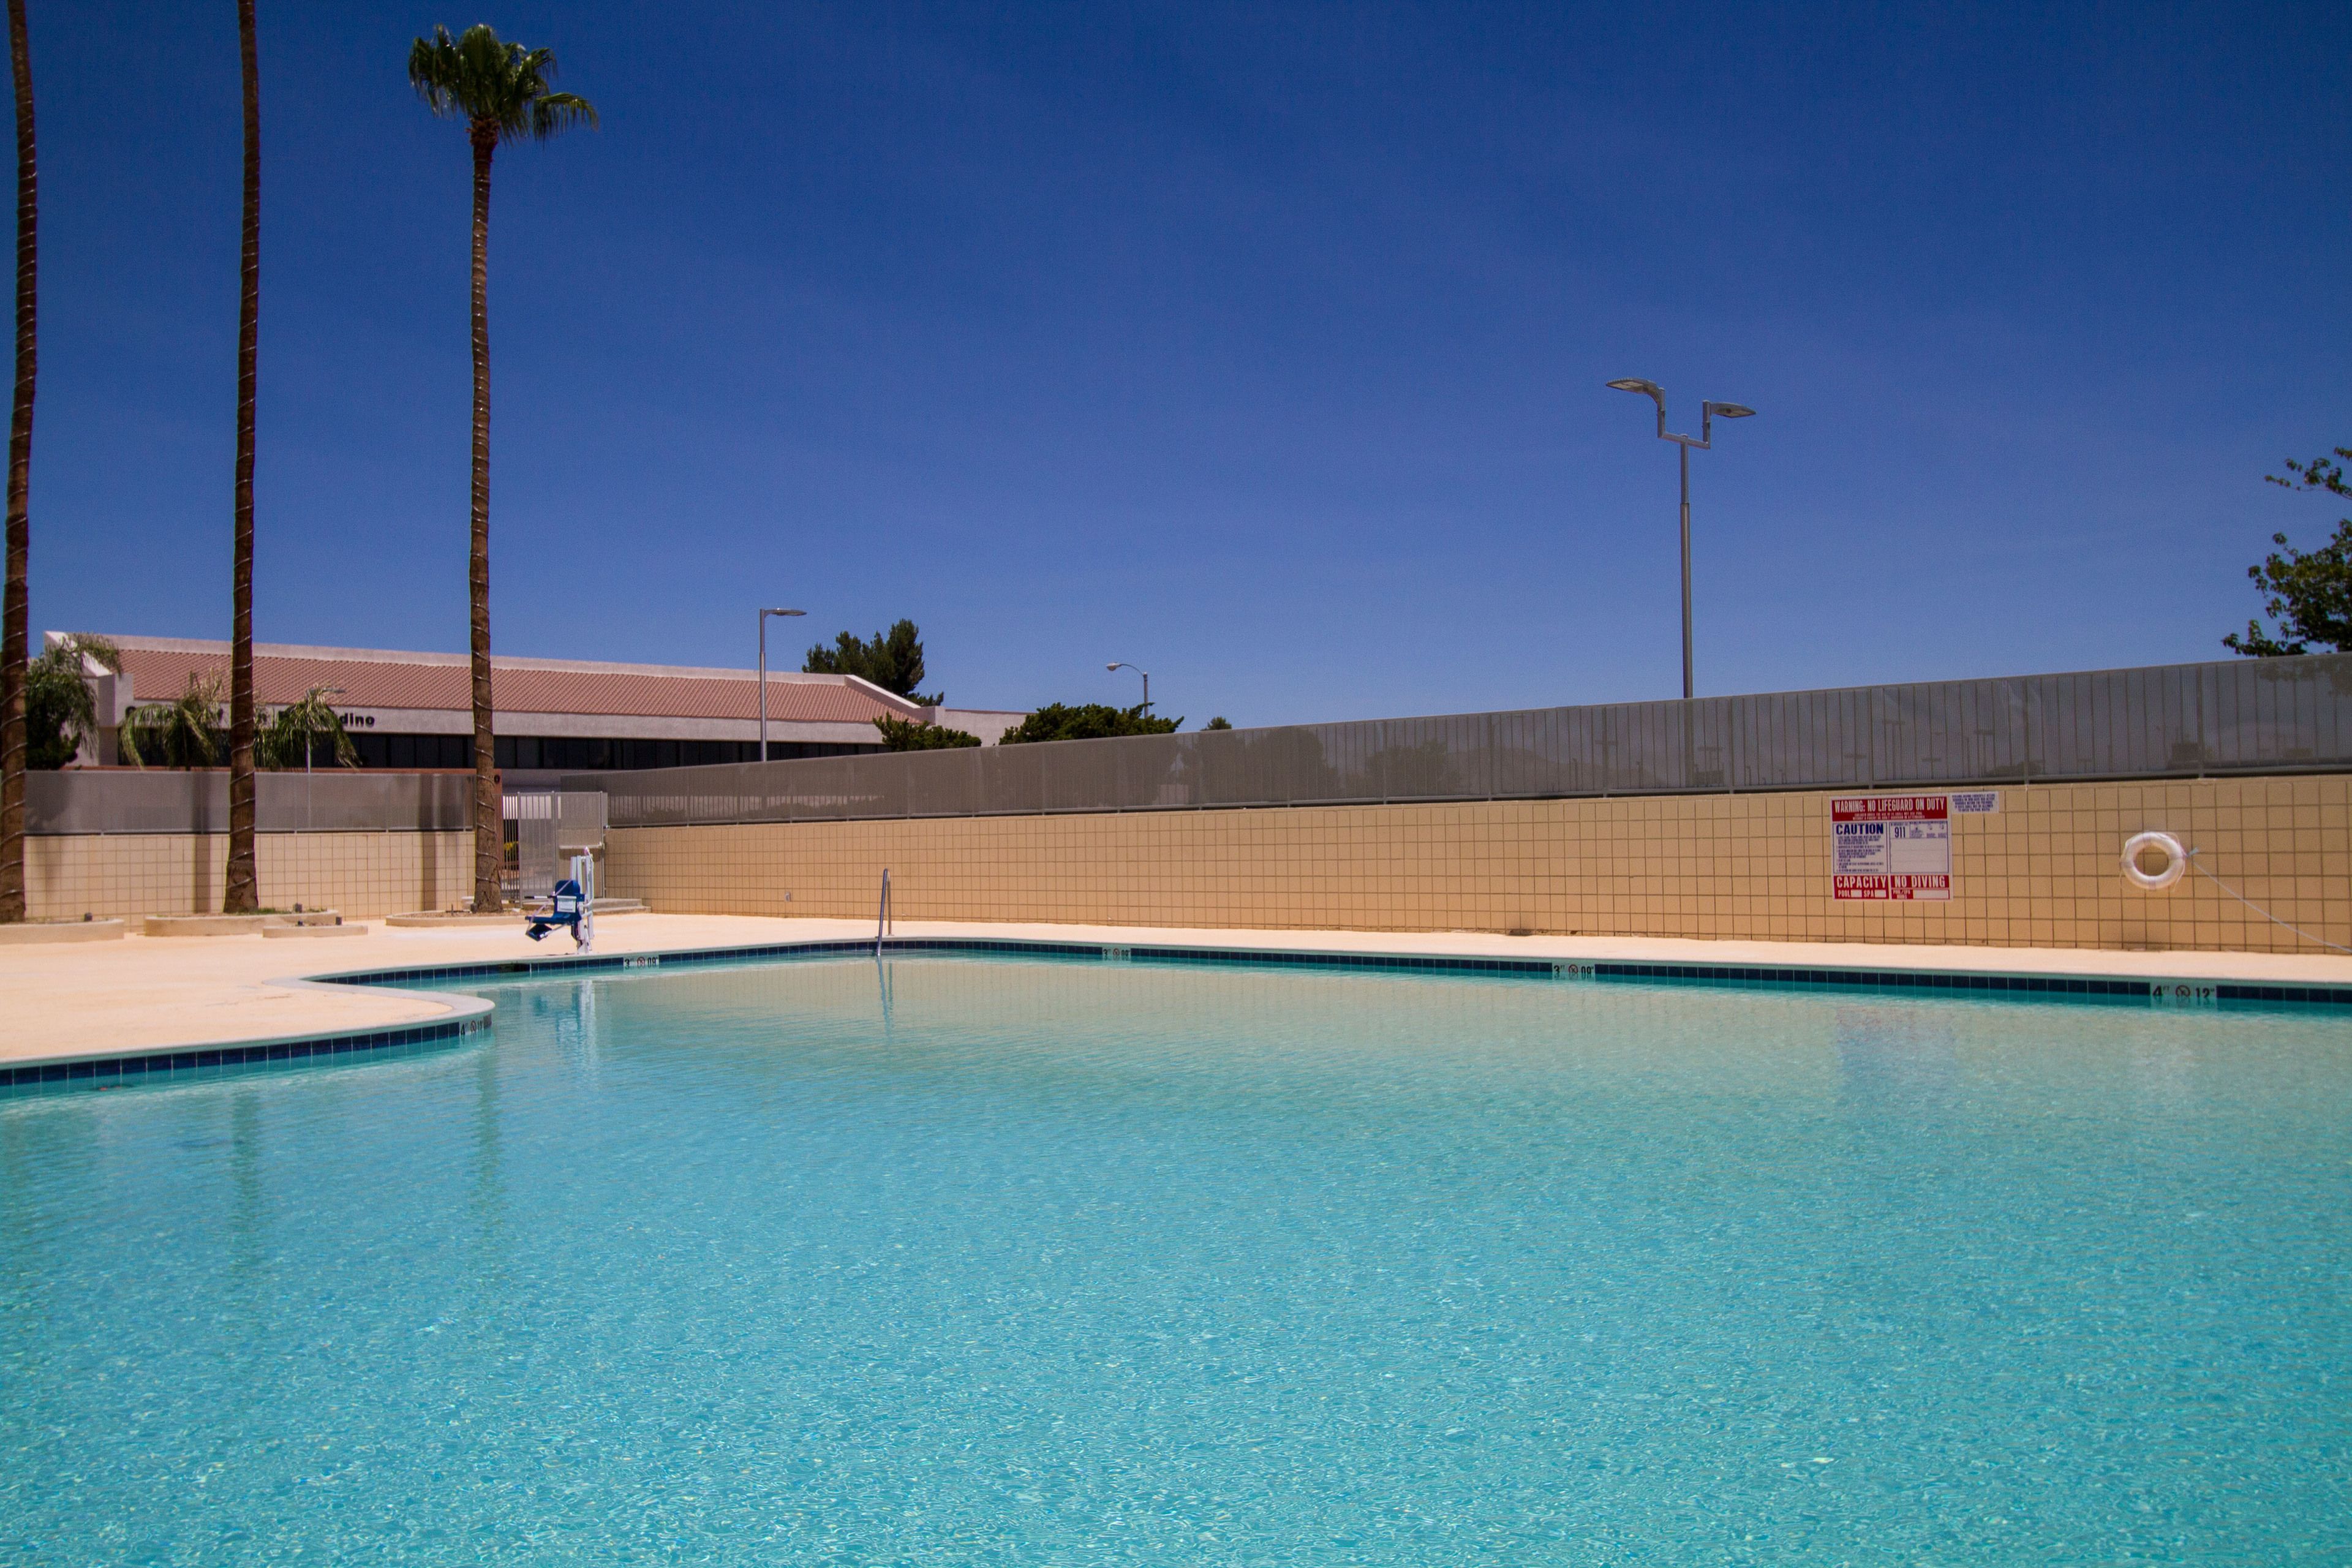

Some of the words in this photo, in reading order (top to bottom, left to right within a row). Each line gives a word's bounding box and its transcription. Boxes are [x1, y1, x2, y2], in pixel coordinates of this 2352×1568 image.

[1834, 800, 1865, 813] WARNING:
[1868, 800, 1876, 812] NO
[1878, 799, 1913, 812] LIFEGUARD
[1915, 798, 1924, 810] ON
[1926, 797, 1944, 810] DUTY
[1836, 823, 1884, 835] CAUTION
[1894, 827, 1905, 838] 911
[1836, 876, 1887, 888] CAPACITY
[1894, 875, 1907, 888] NO
[1912, 875, 1945, 888] DIVING
